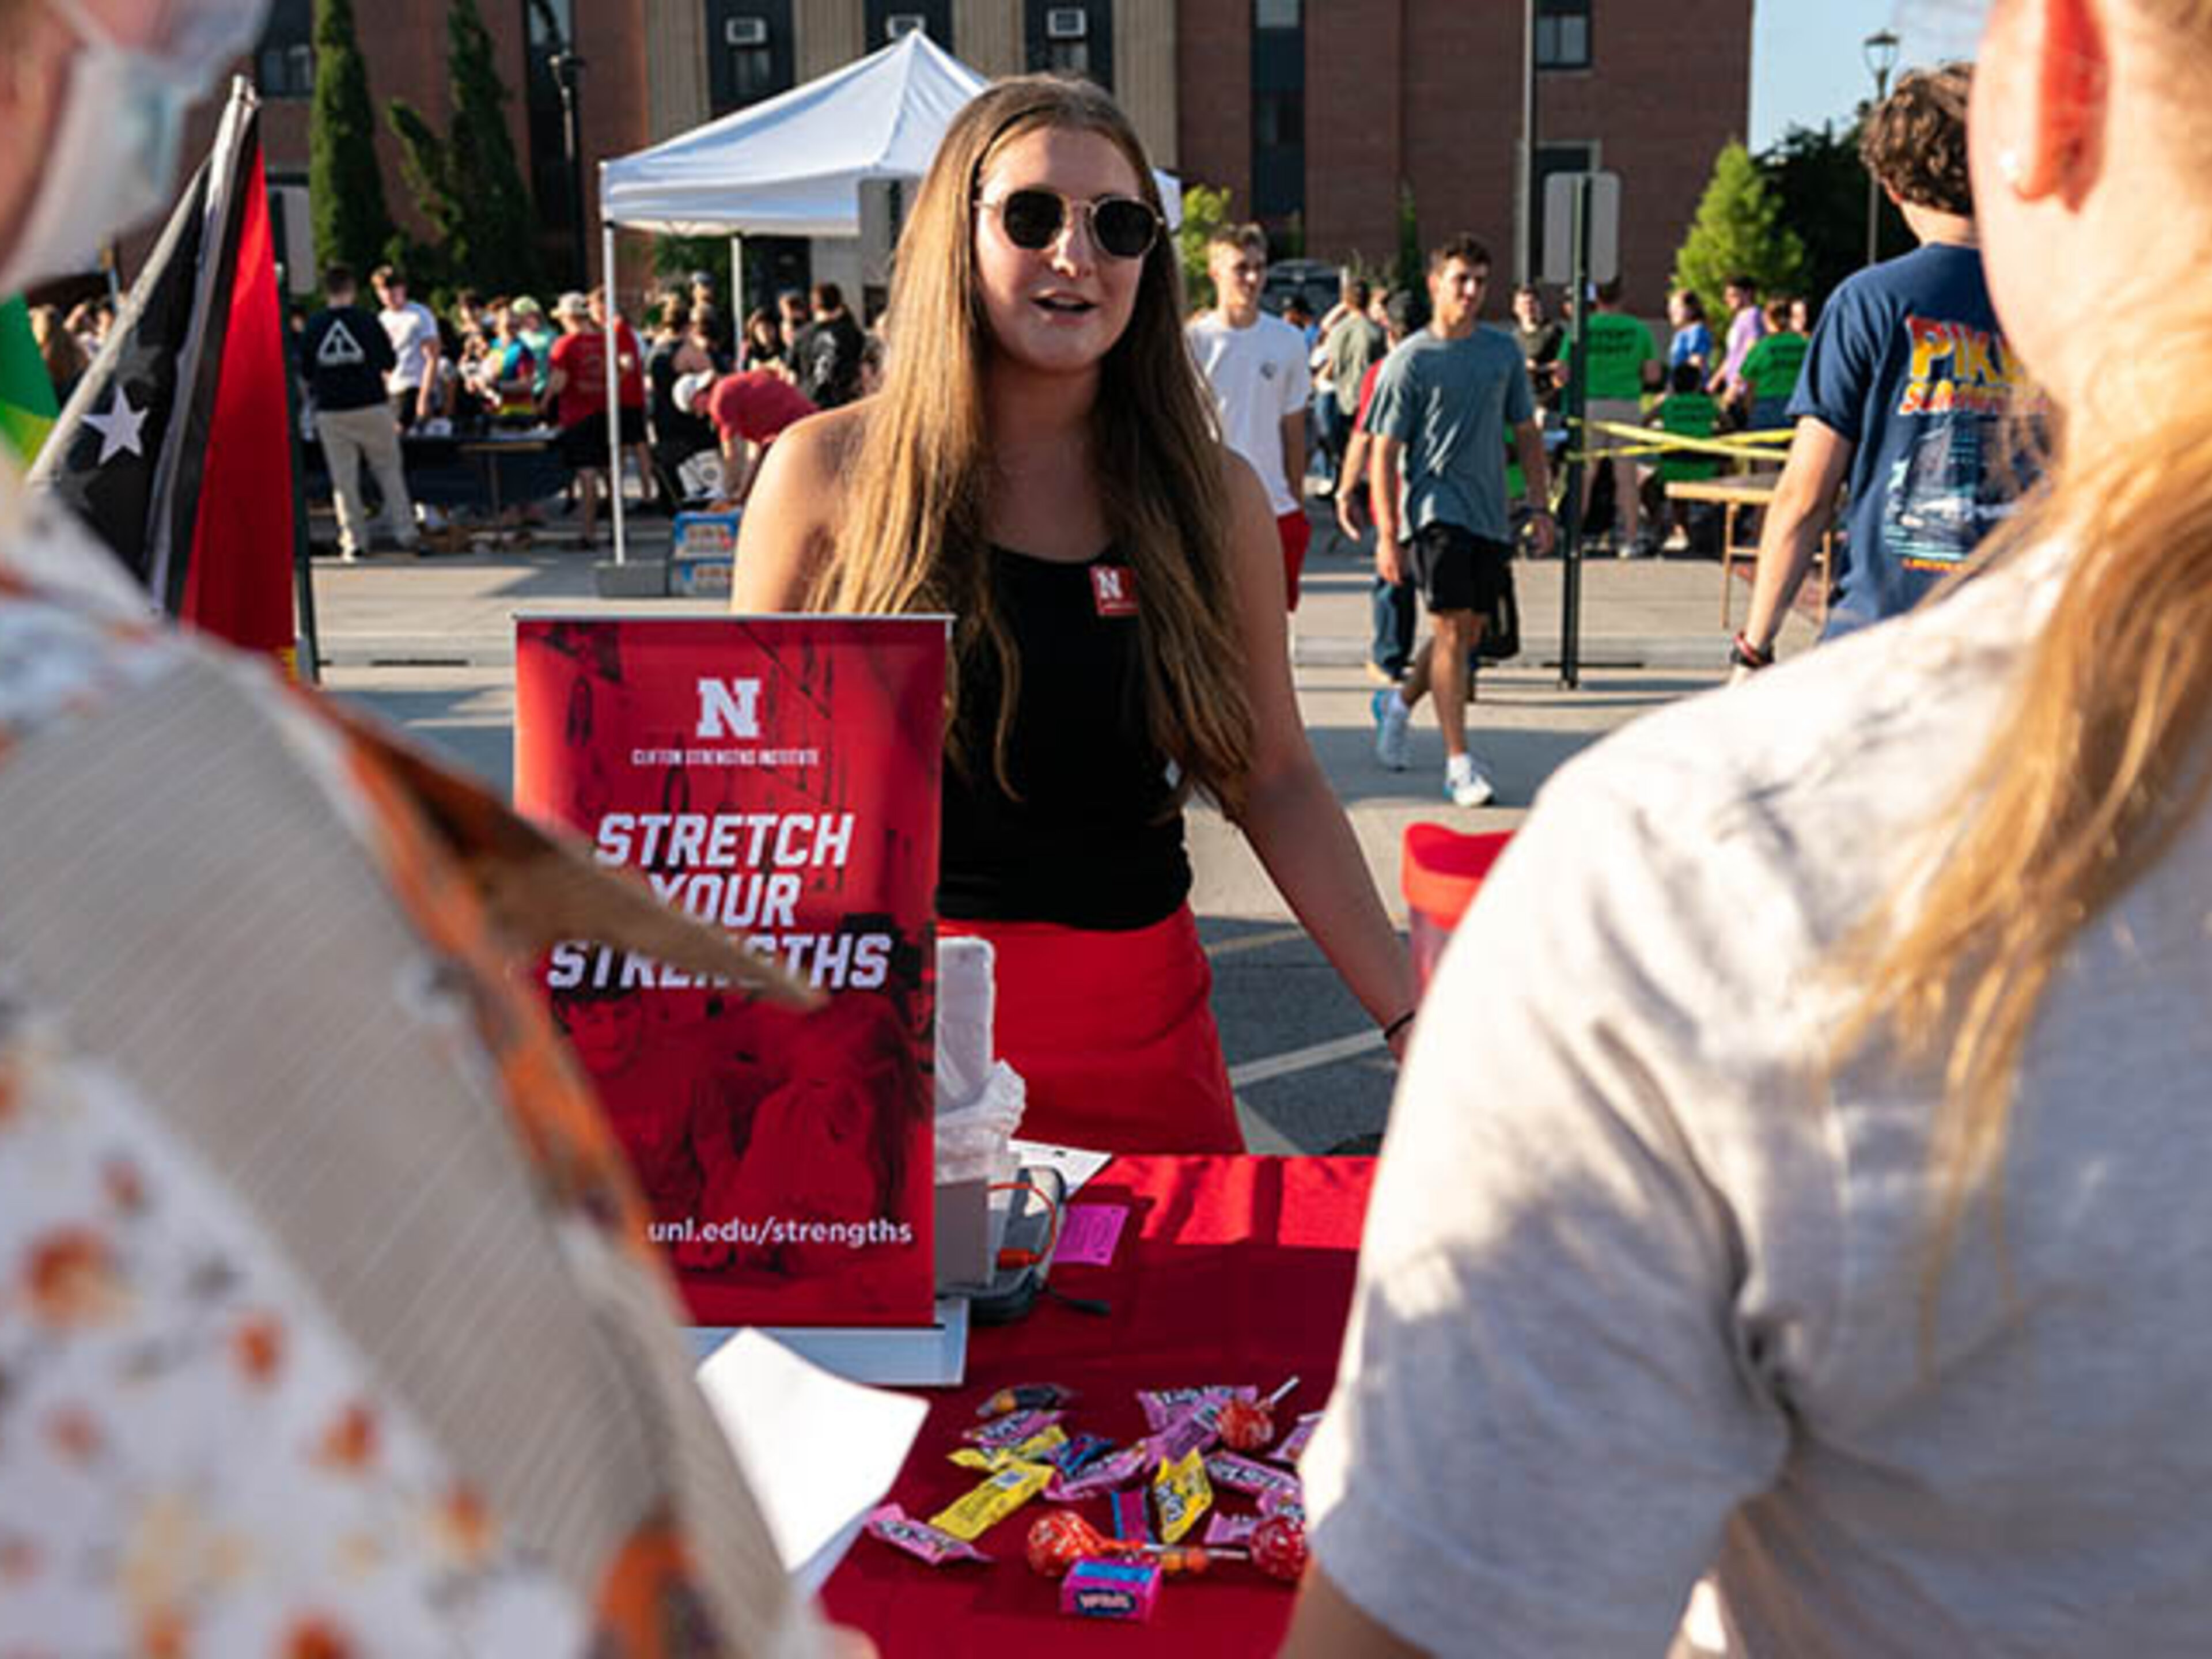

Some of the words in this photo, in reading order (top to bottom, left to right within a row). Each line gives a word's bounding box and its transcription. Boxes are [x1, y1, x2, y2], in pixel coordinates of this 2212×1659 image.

[1097, 570, 1123, 600] N
[696, 677, 760, 738] N
[594, 813, 854, 868] STRETCH
[647, 1217, 913, 1249] unl.edu/strengths
